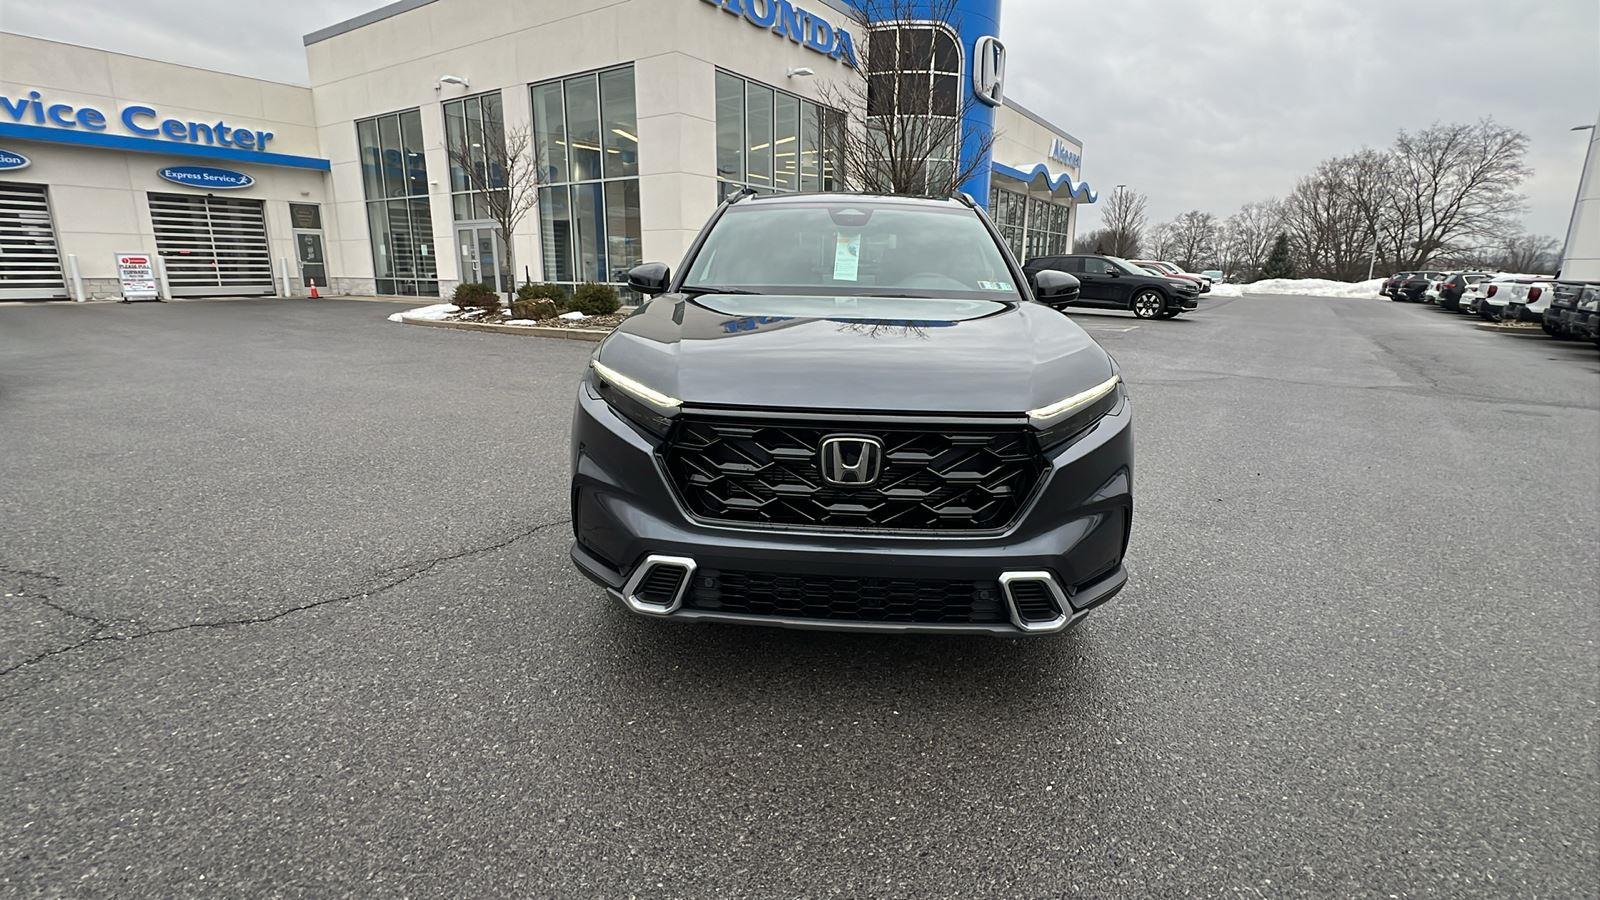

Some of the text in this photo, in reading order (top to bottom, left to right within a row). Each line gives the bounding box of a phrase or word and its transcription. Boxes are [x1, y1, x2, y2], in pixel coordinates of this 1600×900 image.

[701, 0, 860, 68] ONDA
[121, 105, 274, 151] Center
[165, 169, 236, 183] Express Service
